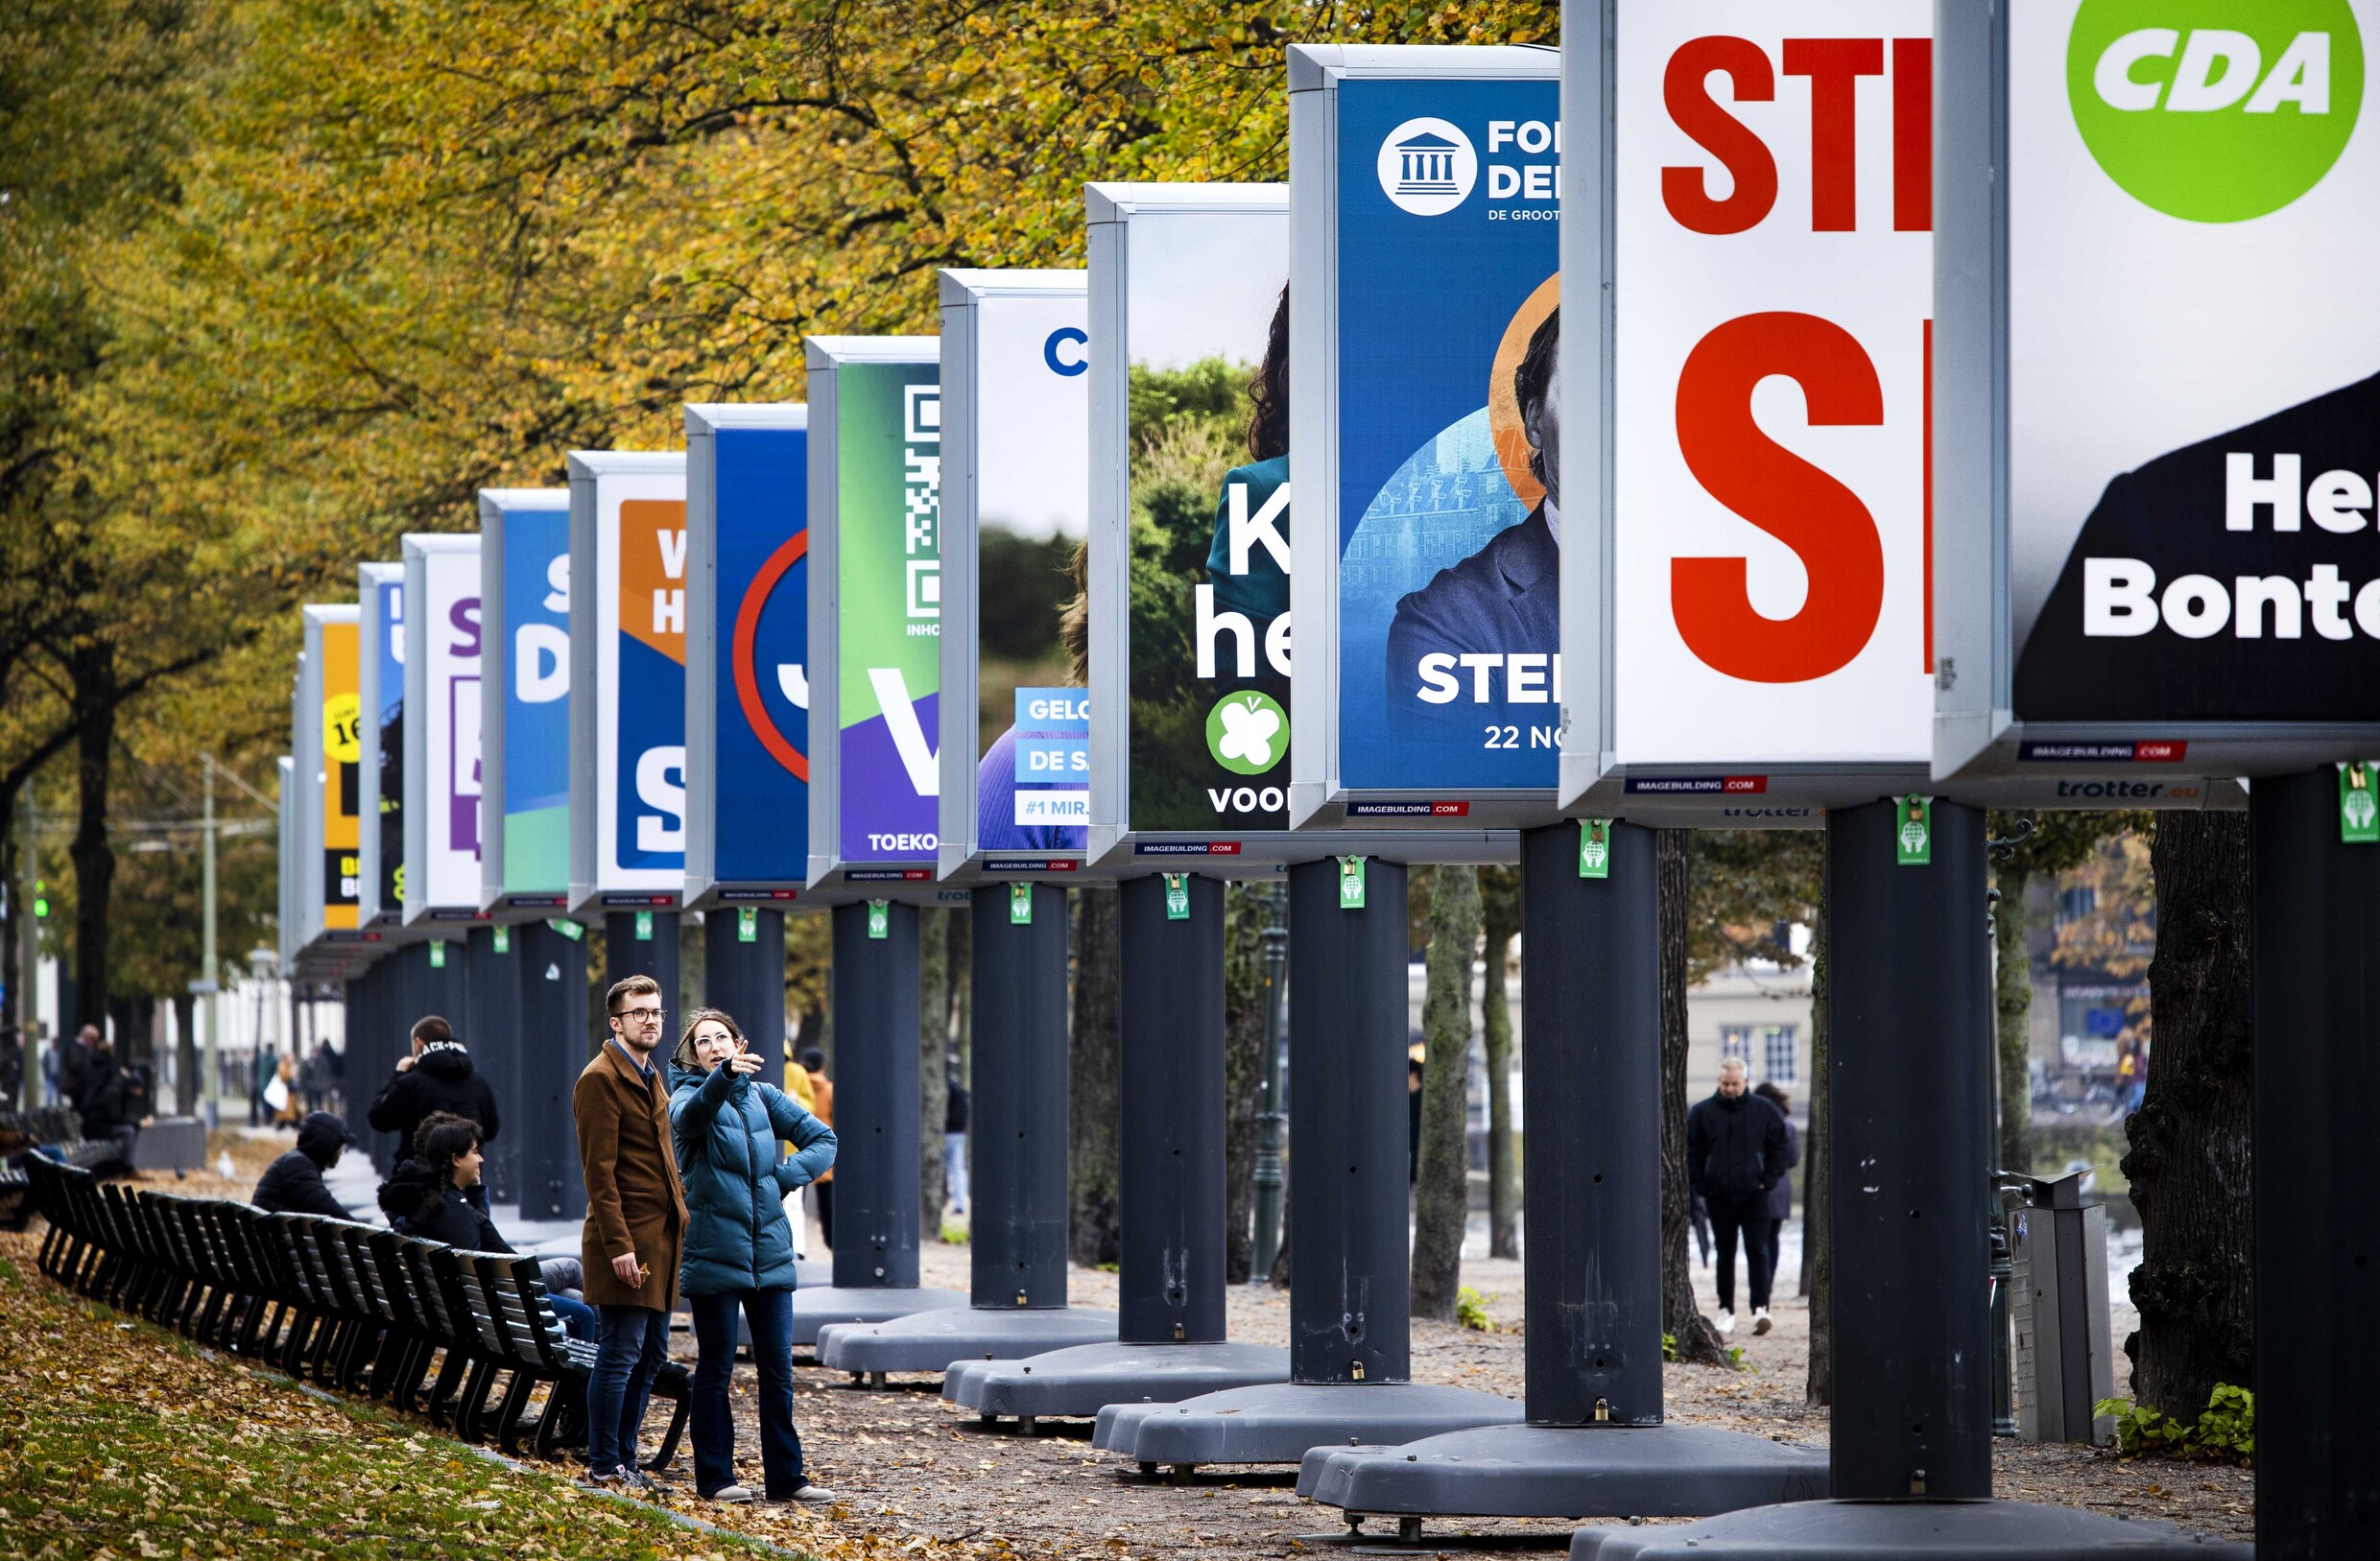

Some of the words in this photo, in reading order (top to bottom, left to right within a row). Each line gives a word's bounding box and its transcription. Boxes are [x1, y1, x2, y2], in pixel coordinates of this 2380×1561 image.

[2093, 27, 2330, 115] CDA
[1488, 120, 1561, 154] FO
[1488, 164, 1561, 200] DE
[1488, 209, 1508, 221] DE
[1043, 326, 1089, 377] C
[1670, 310, 1934, 684] S
[2225, 452, 2380, 534] He
[1227, 482, 1292, 576] K
[1416, 651, 1562, 705] STE
[1484, 724, 1520, 749] 22
[1029, 750, 1065, 771] DE
[1070, 750, 1090, 771] S
[1025, 800, 1046, 816] #1
[1050, 800, 1090, 816] MIR
[1206, 786, 1292, 814] VOO
[868, 833, 939, 852] TOEKO
